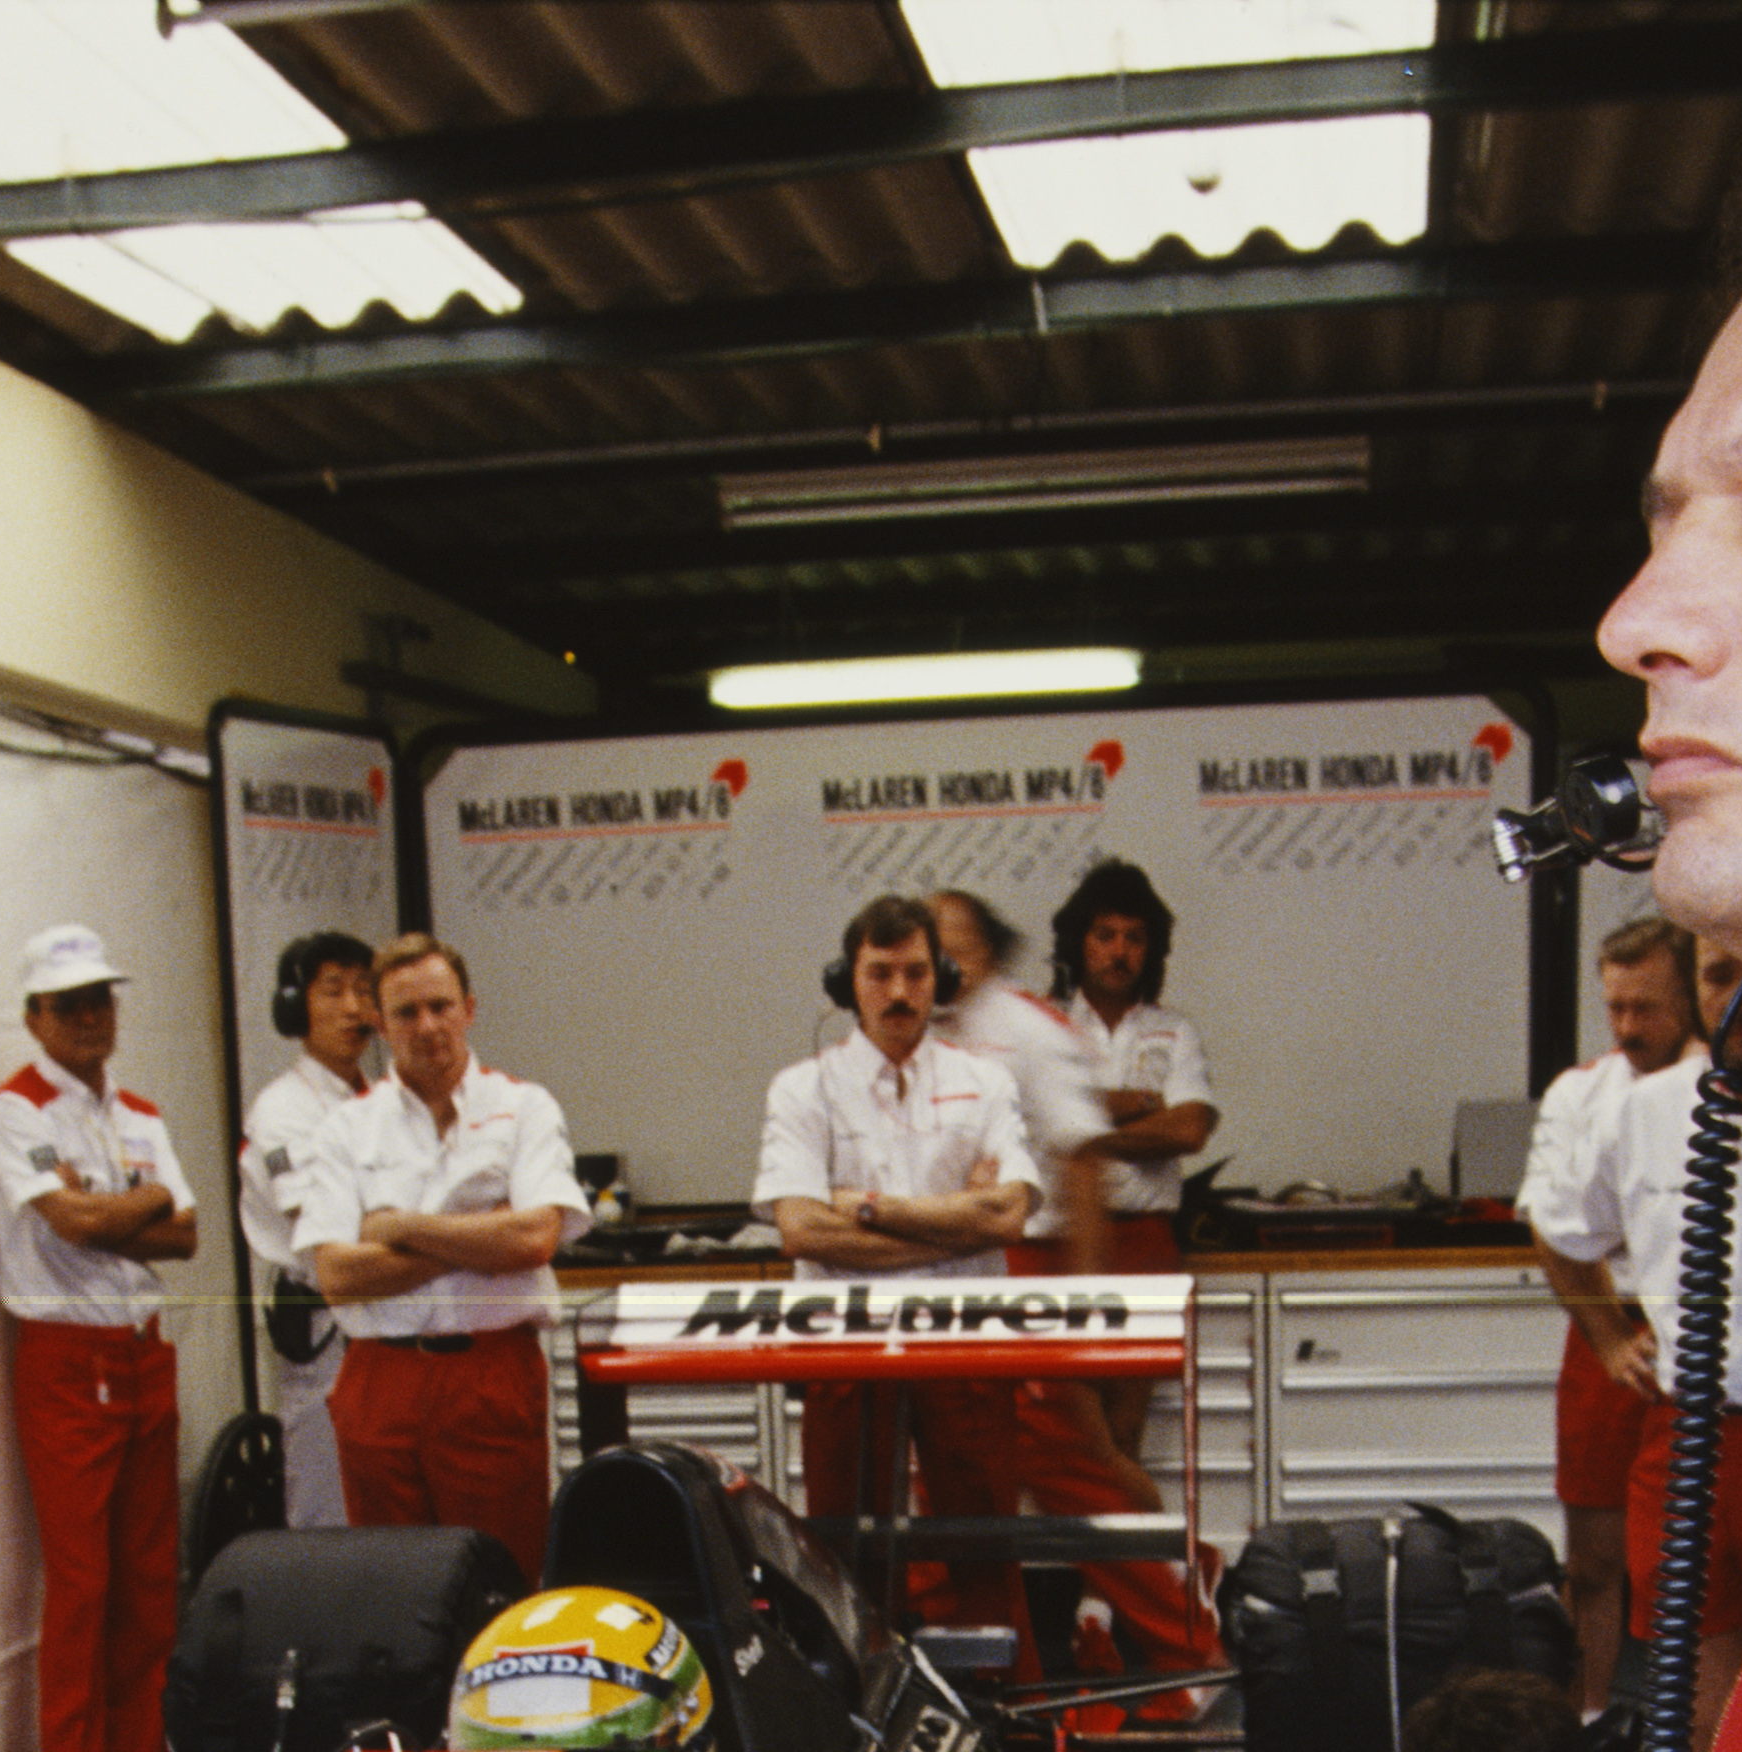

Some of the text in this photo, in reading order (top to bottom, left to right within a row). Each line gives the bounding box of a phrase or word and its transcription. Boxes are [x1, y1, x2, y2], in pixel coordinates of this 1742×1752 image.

[822, 775, 927, 811] McLAREN
[937, 769, 1015, 805] HONDA
[1199, 757, 1307, 793] McLAREN
[1318, 754, 1398, 788] HONDA
[459, 795, 560, 831] McLAREN
[568, 790, 643, 824] HONDA
[674, 1284, 1131, 1338] McLaren
[469, 1654, 609, 1687] HONDA
